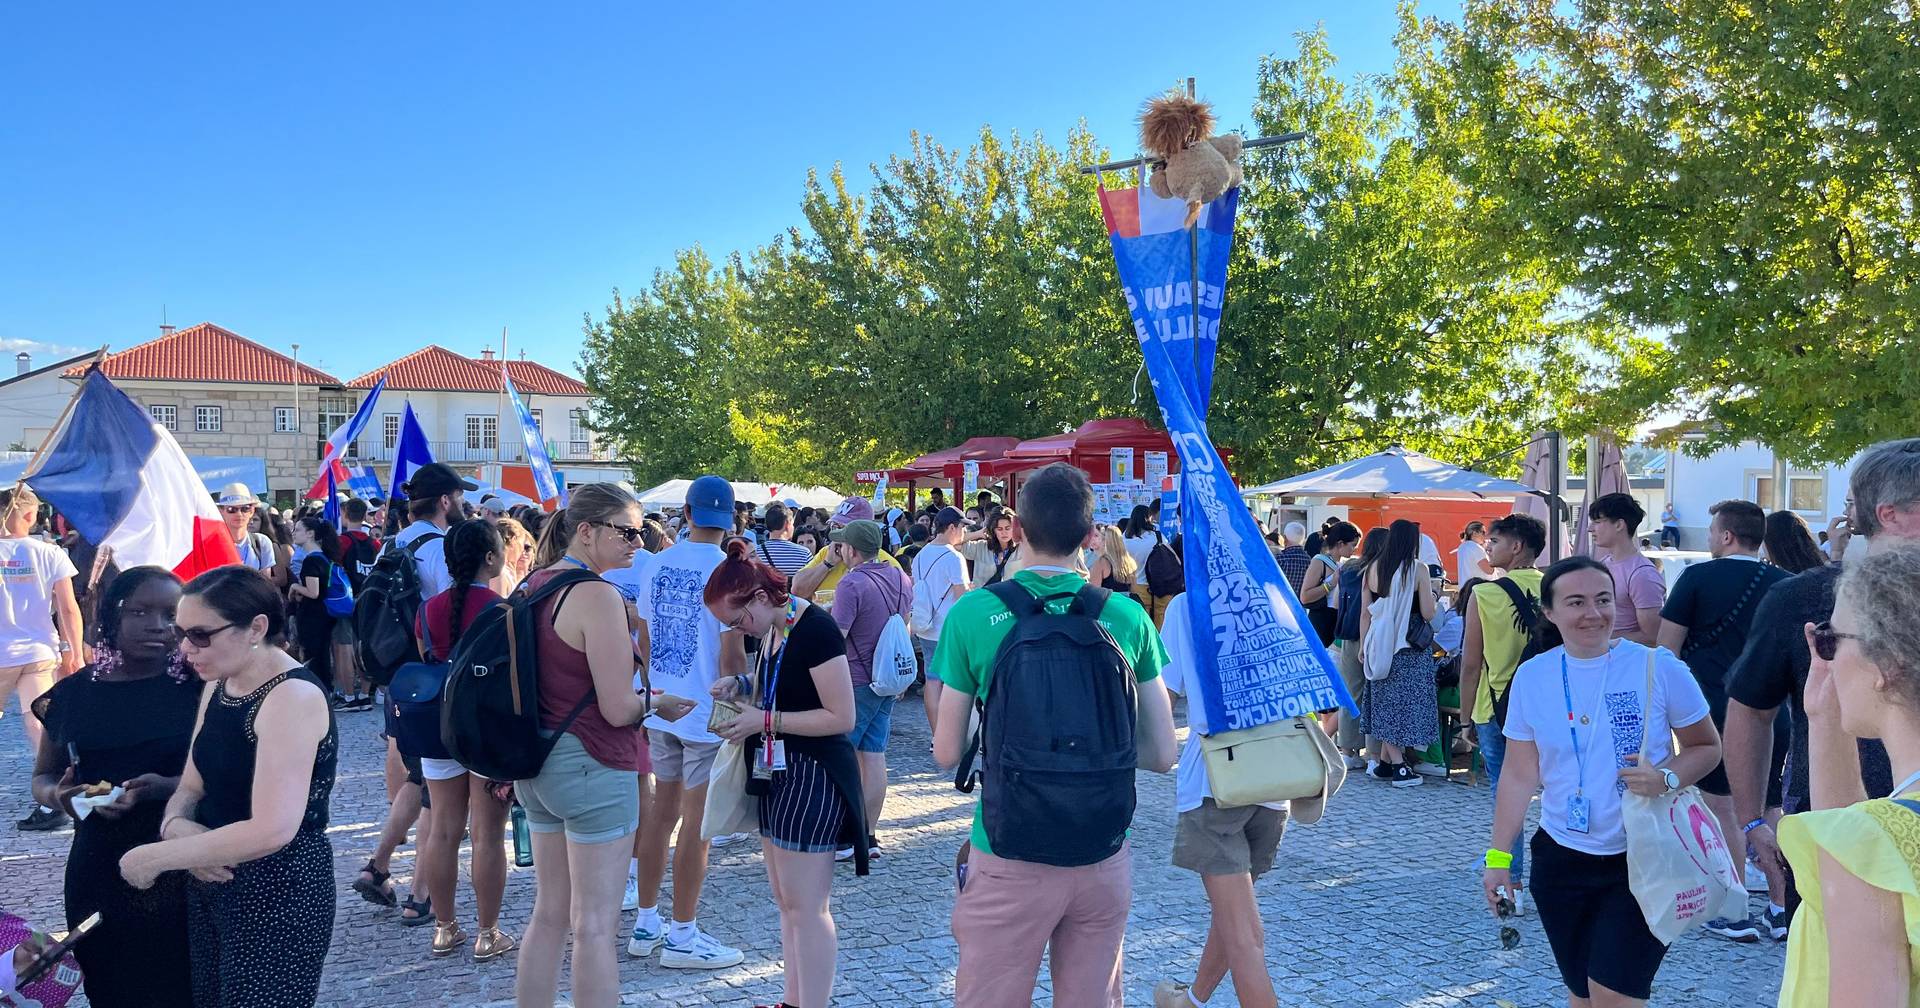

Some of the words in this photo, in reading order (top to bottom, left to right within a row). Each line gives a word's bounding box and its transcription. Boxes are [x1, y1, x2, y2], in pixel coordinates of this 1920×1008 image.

[1208, 572, 1250, 616] 23
[1212, 612, 1239, 657] 7
[1221, 679, 1245, 693] FAIRE
[1243, 669, 1260, 686] LA
[1613, 714, 1639, 723] LYON
